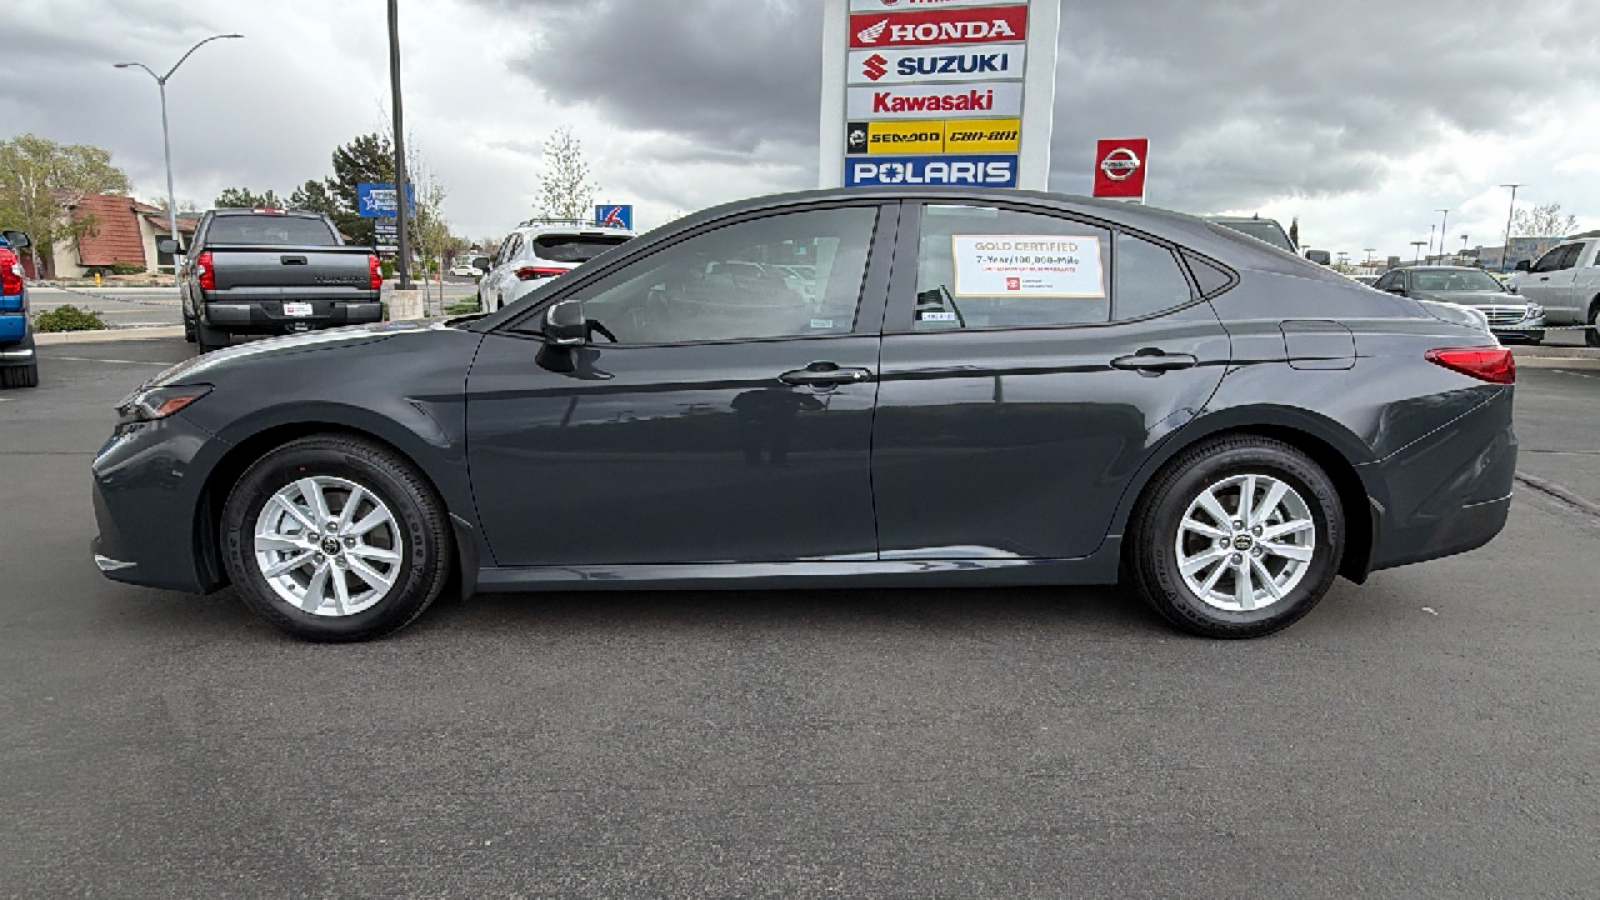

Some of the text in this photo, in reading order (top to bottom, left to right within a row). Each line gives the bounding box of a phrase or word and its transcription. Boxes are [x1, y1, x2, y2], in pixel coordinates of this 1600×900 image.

[889, 19, 1015, 42] HONDA
[897, 53, 1008, 76] SUZUKI
[873, 89, 993, 113] Kawasaki
[854, 162, 1011, 183] POLARIS
[974, 241, 1078, 252] GOLD CERTIFIED
